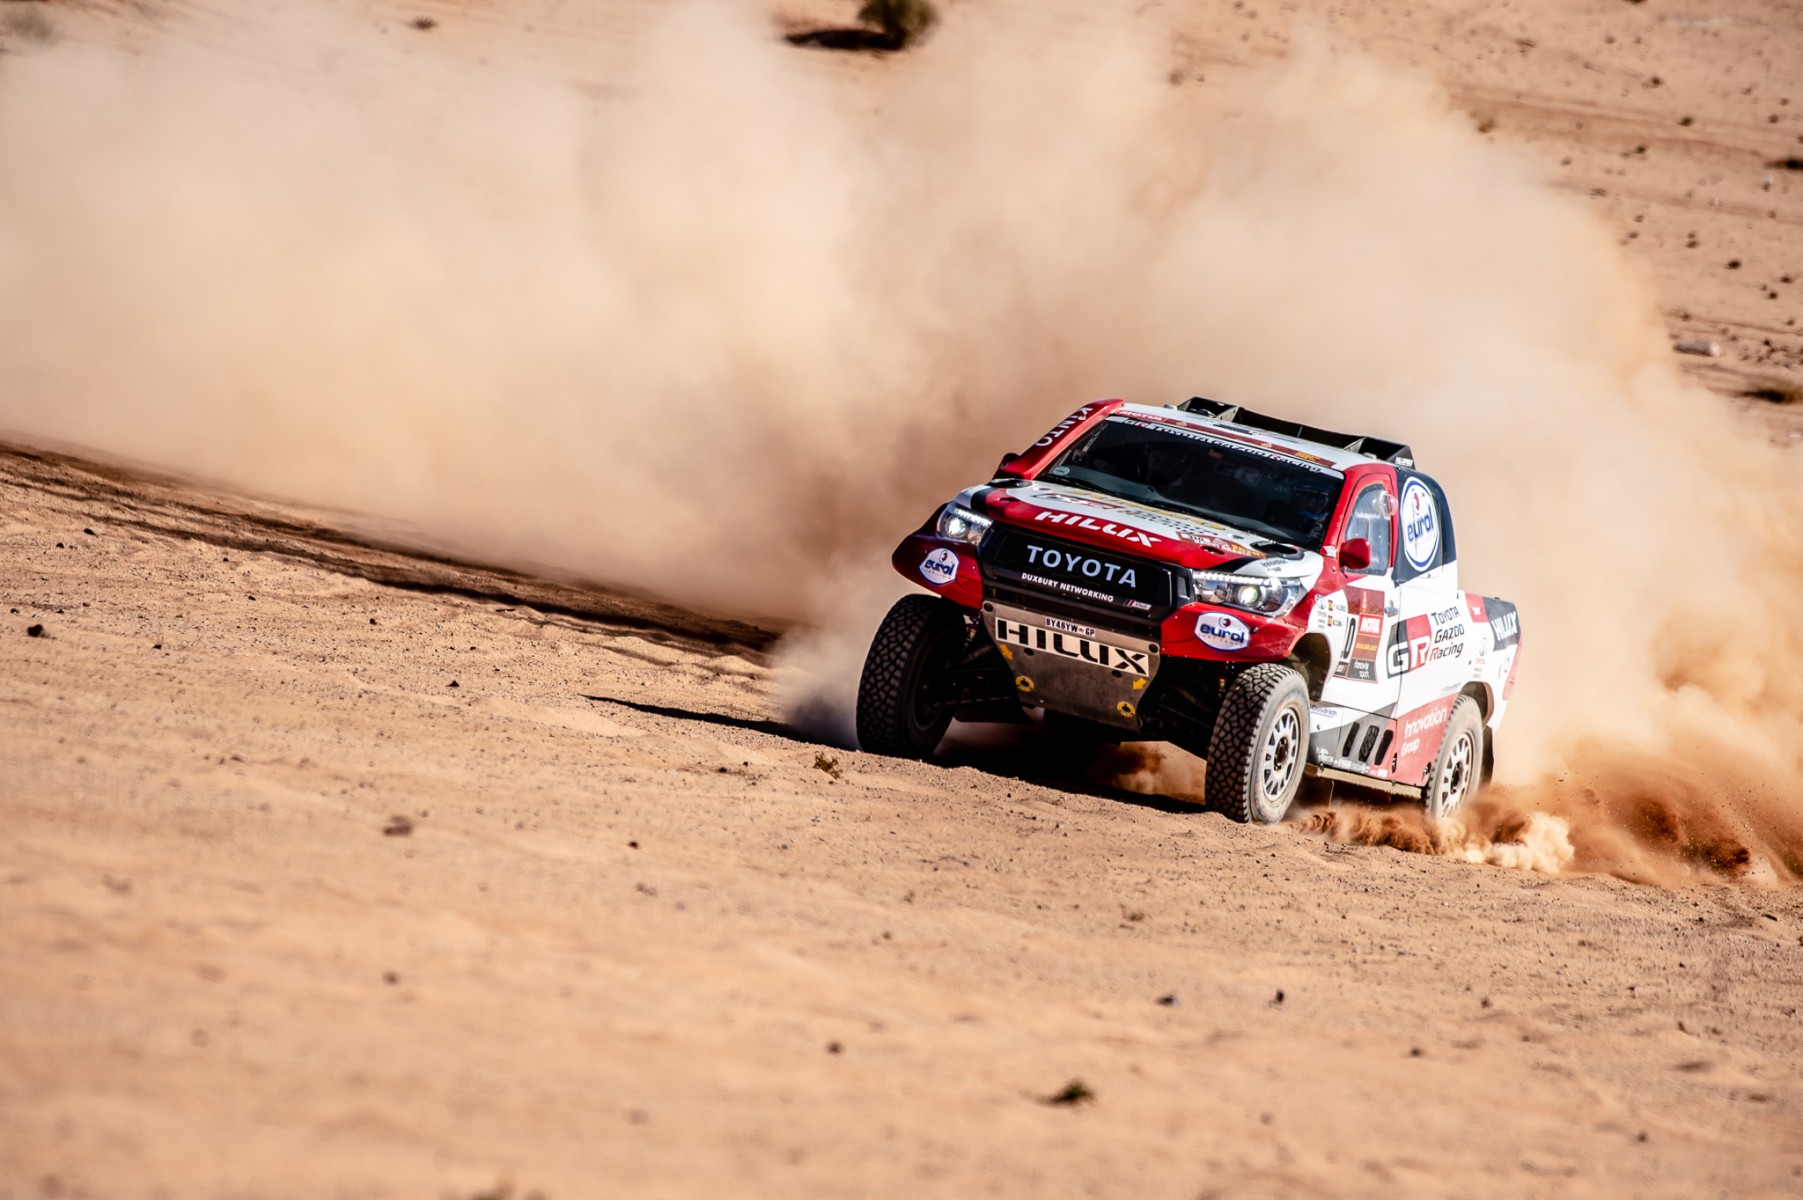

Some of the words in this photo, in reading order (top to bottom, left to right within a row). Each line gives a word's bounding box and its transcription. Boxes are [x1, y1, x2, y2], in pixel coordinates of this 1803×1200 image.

[1034, 407, 1093, 446] KINTO
[1035, 511, 1162, 547] HILUX
[1407, 503, 1434, 542] eurol
[924, 559, 955, 576] eurol
[1027, 545, 1137, 588] TOYOTA
[1021, 572, 1059, 589] DUXBURY
[1059, 581, 1114, 602] NETWORKING
[1360, 616, 1381, 635] MOTUL
[1431, 606, 1461, 626] TOYOTA
[997, 618, 1147, 676] HILUX
[1200, 623, 1245, 643] eurol
[1434, 623, 1465, 644] GAZOO
[1387, 635, 1432, 676] GR
[1429, 641, 1464, 661] Racing
[1404, 706, 1447, 739] Innovation
[1401, 738, 1420, 757] Group
